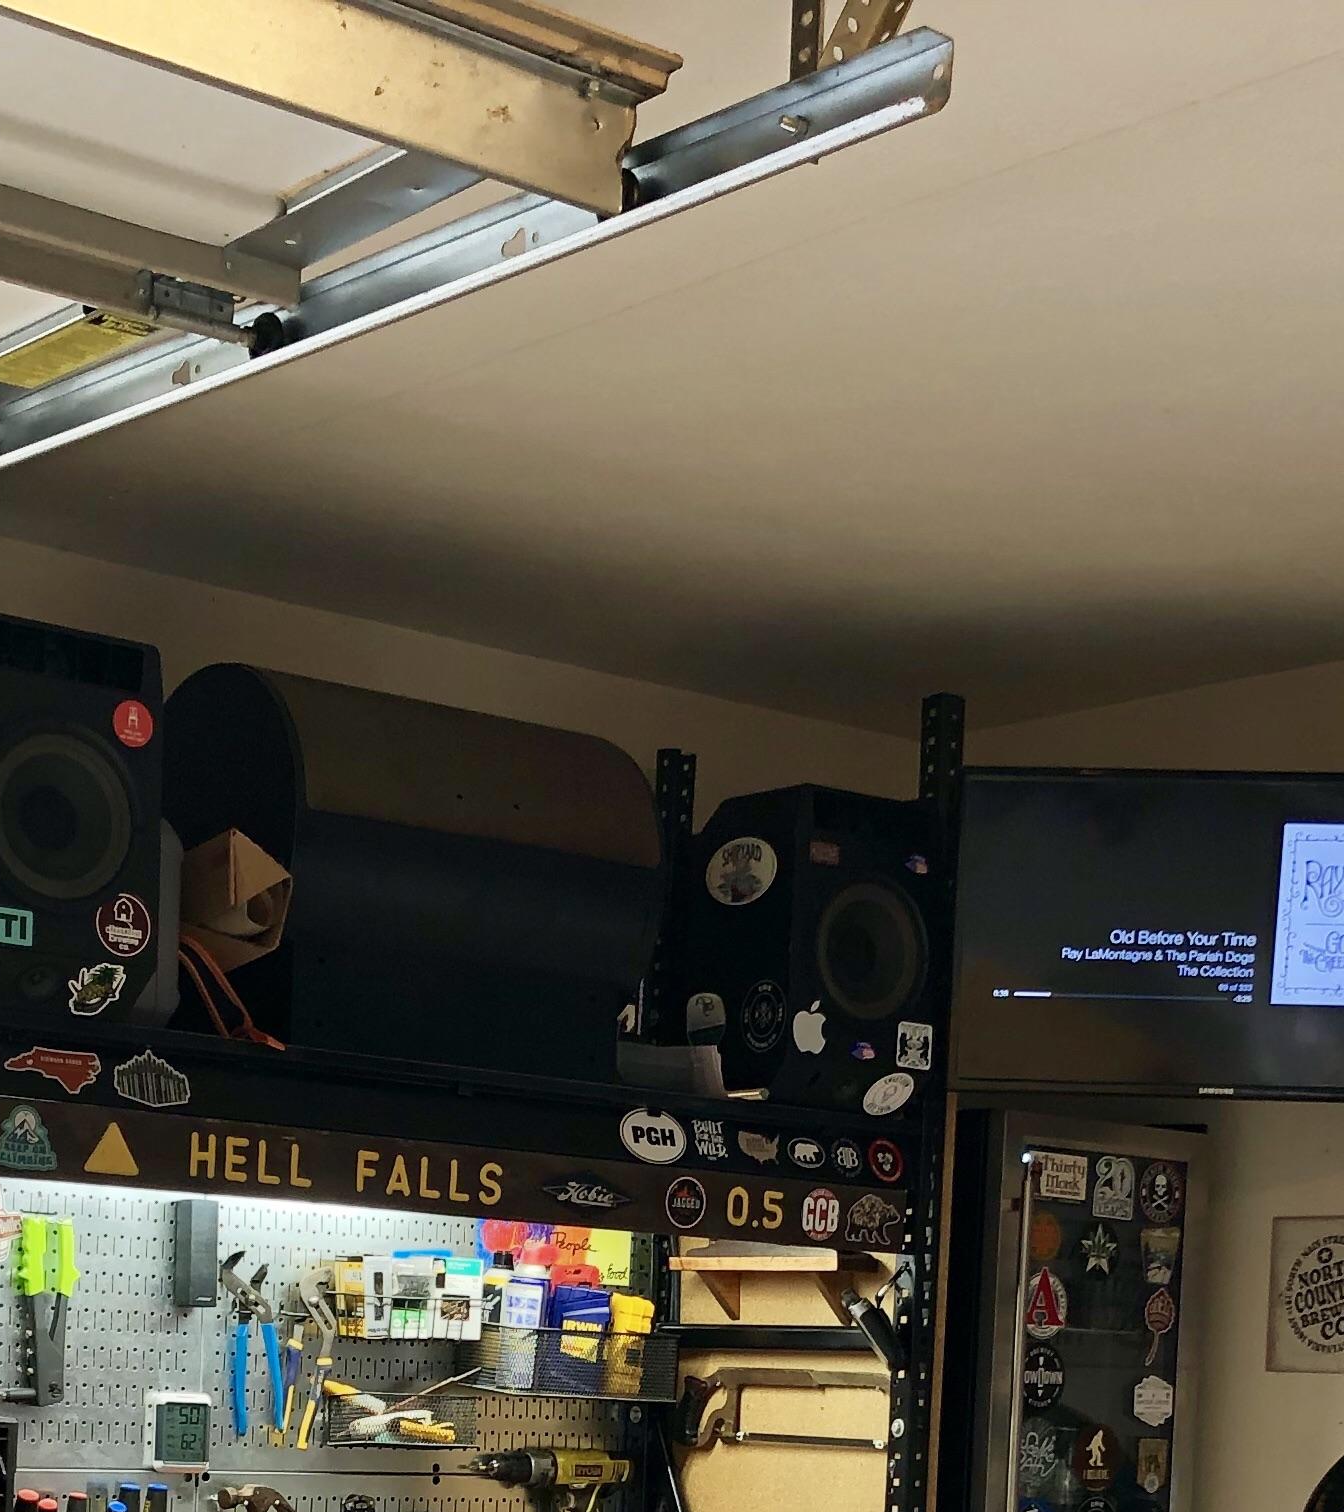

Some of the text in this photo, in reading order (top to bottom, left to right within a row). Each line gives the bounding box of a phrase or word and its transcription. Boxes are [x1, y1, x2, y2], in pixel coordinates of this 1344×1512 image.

[1110, 929, 1257, 947] Old Before Your Time
[1061, 947, 1256, 966] Ray LaMontagne & The Pariah Dogs
[1177, 964, 1255, 978] The Collection
[631, 1125, 676, 1147] PGH
[691, 1119, 724, 1134] BUILT
[0, 1153, 54, 1166] CLIMBING
[189, 1131, 503, 1206] HELL FALLS
[557, 1182, 616, 1208] Hobie
[671, 1198, 701, 1210] JAGGED
[726, 1185, 784, 1230] 0.5
[802, 1196, 840, 1232] GCB
[551, 1231, 600, 1256] People
[562, 1319, 603, 1333] IRWIN
[179, 1406, 201, 1425] 50
[180, 1433, 197, 1450] 62
